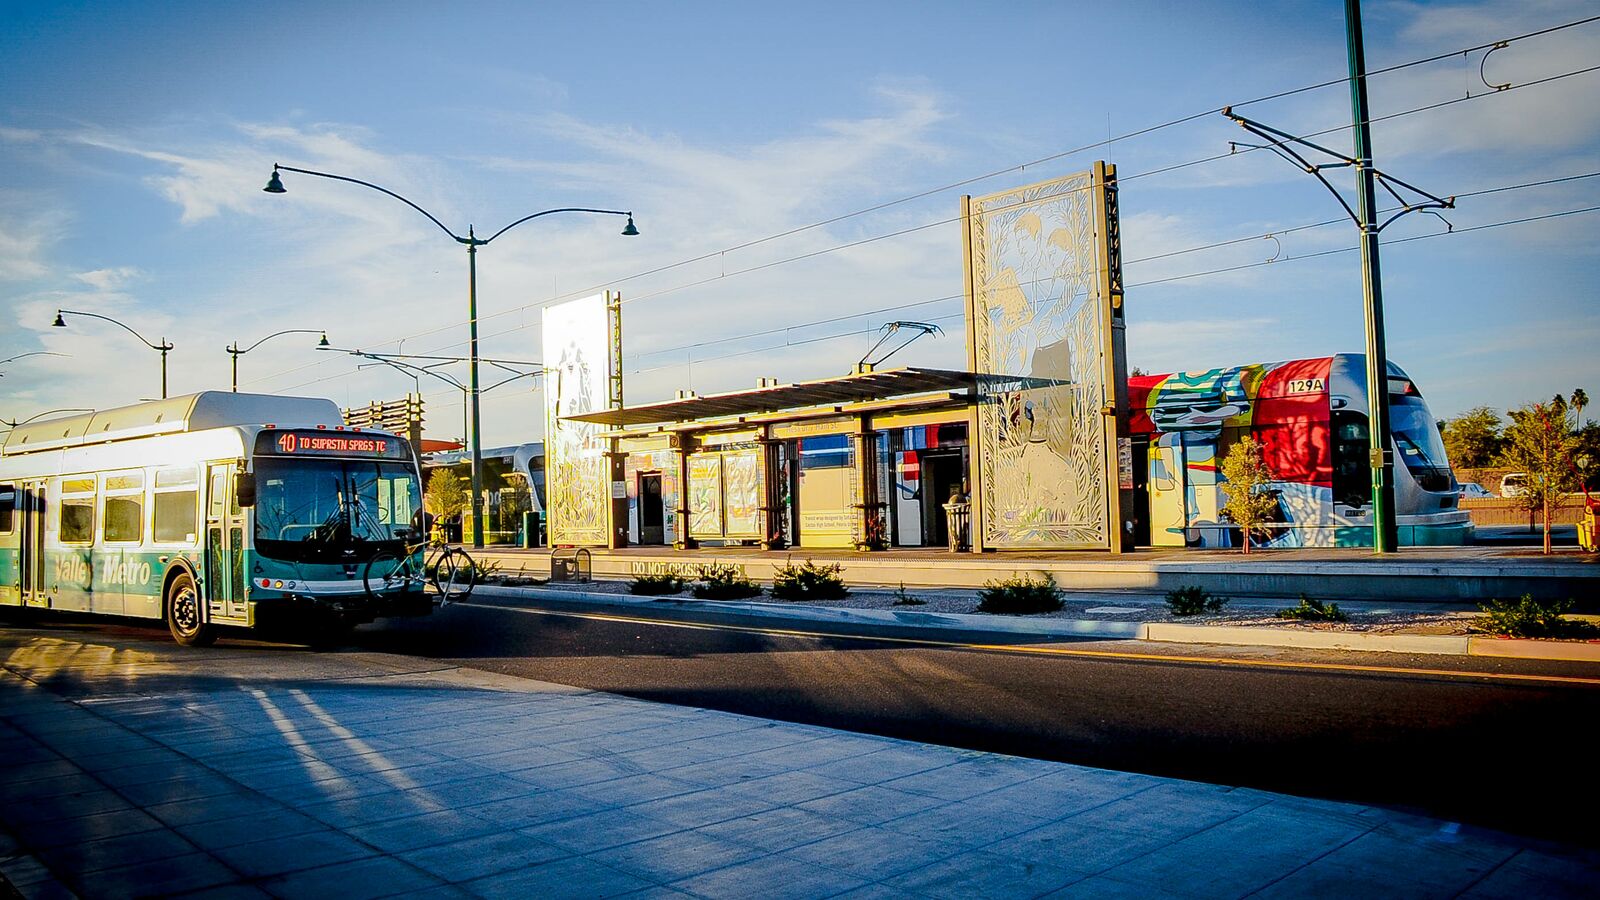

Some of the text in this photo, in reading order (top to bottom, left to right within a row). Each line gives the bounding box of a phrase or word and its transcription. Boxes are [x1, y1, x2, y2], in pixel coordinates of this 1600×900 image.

[1290, 379, 1324, 392] 129A
[278, 433, 387, 453] 40 TO SUPRSTN SPRGS TC
[102, 555, 151, 585] Metro
[632, 561, 646, 575] DO
[648, 562, 666, 576] NOT
[669, 562, 701, 577] CROSS
